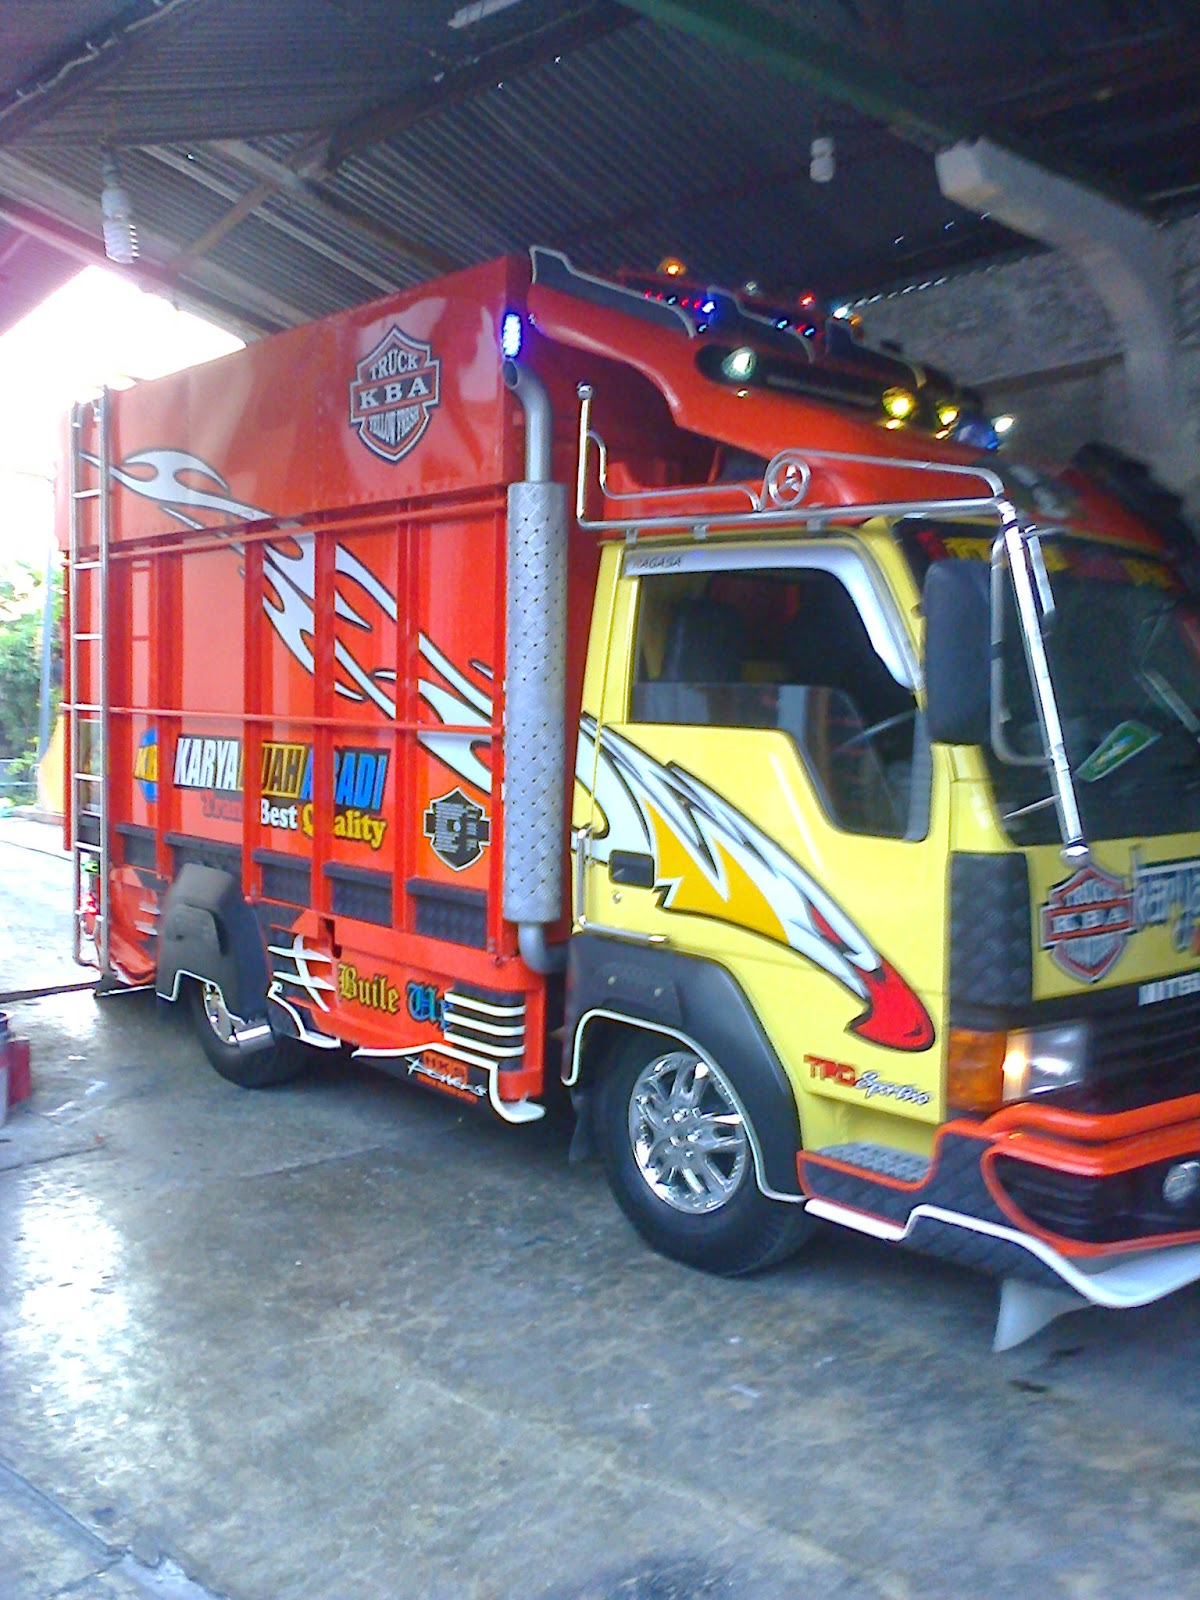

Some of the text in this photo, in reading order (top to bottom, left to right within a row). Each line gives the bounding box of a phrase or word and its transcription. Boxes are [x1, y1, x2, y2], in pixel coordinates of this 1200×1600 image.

[368, 349, 418, 381] TRUCK
[174, 737, 239, 791] KARYA
[260, 797, 298, 830] Best
[302, 803, 387, 849] Qality
